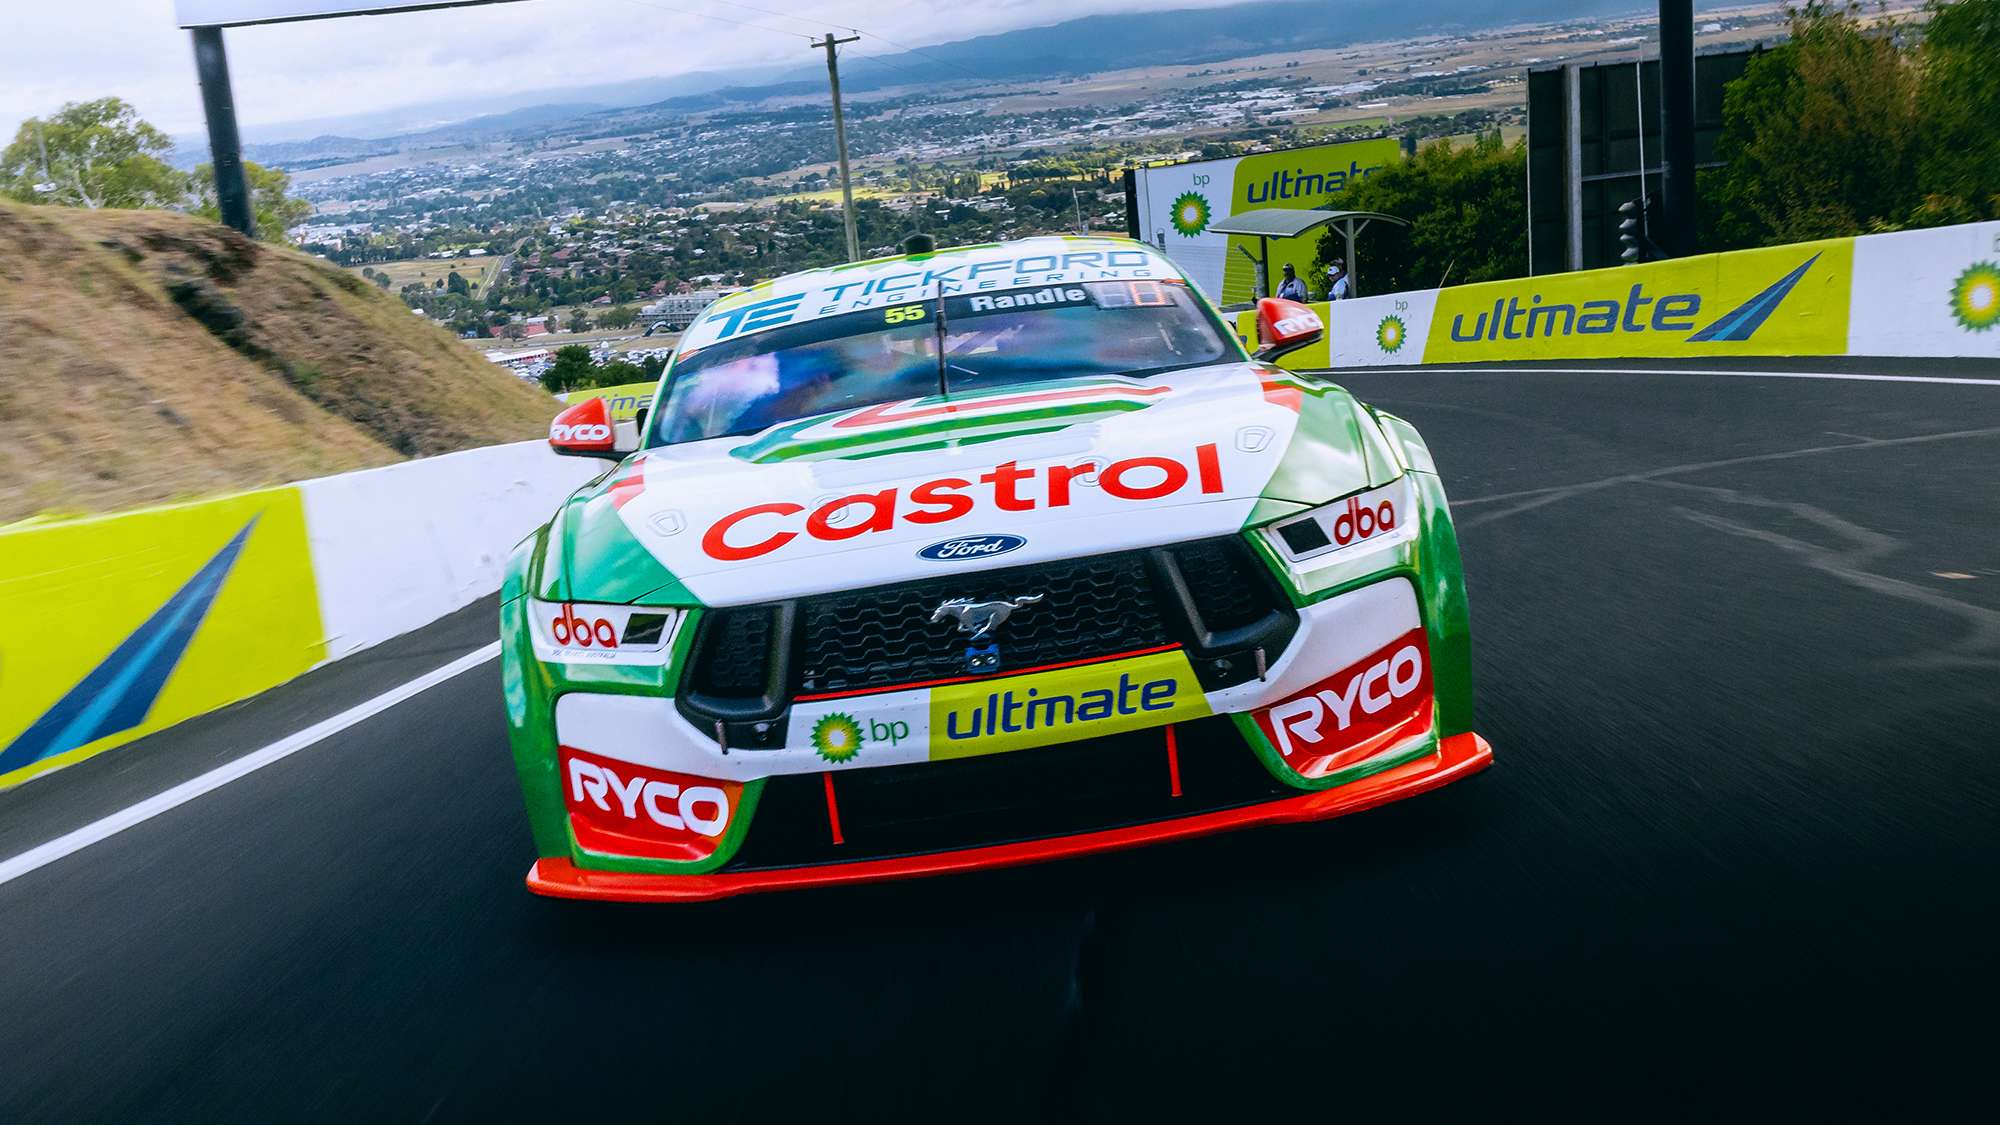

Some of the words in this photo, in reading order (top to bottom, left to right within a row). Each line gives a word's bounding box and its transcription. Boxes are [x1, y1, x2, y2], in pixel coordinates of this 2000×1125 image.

[1193, 173, 1210, 187] bp
[820, 269, 1151, 315] ENGINEERING
[823, 251, 1149, 302] TICKFORD
[970, 287, 1087, 312] Randle
[884, 304, 926, 324] 55
[1395, 299, 1408, 313] bp
[1451, 283, 1701, 342] ultimate
[701, 443, 1224, 561] Castrol
[1334, 496, 1396, 546] dba
[937, 539, 1003, 559] Ford
[552, 603, 618, 648] dba
[947, 673, 1178, 741] ultimate
[1269, 645, 1423, 756] RYCO
[870, 718, 909, 747] bp
[569, 757, 729, 837] RYCO
